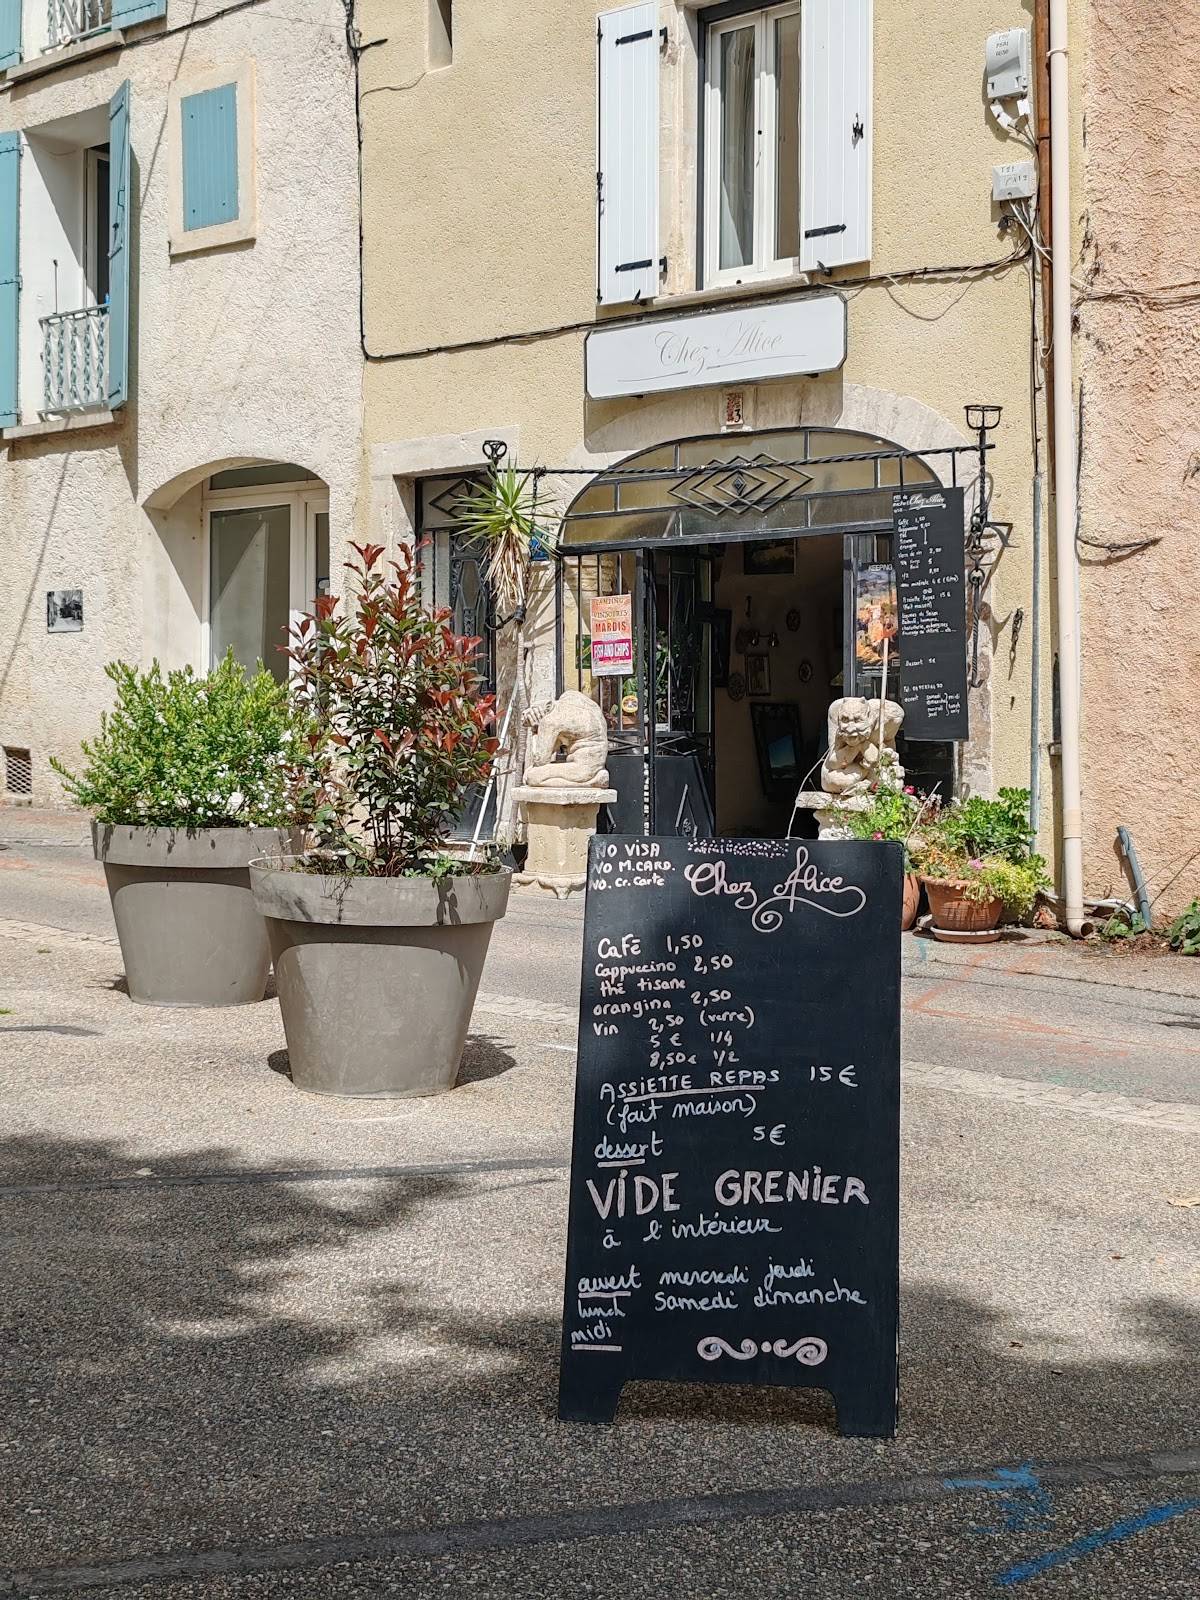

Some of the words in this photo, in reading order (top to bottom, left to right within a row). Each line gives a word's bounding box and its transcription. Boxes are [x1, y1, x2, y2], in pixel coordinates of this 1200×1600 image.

[655, 330, 709, 377] Chez
[717, 320, 784, 358] Alice
[595, 621, 627, 633] MARDIS
[614, 641, 630, 657] CHIPS
[595, 841, 618, 860] NO
[590, 860, 613, 875] NO
[684, 860, 757, 910] Chez
[666, 934, 703, 955] 1,50
[594, 960, 677, 985] Cappuccino
[693, 954, 733, 975] 2,50
[637, 977, 686, 992] tisane
[593, 999, 672, 1019] orangina
[690, 989, 732, 1007] 2,50
[648, 1014, 685, 1033] 2,50
[700, 1005, 755, 1029] (verre)
[649, 1034, 661, 1048] 5
[669, 1033, 683, 1047] €
[710, 1030, 733, 1047] 1/4
[712, 1050, 740, 1067] 1/2
[709, 1069, 780, 1088] REPAS
[671, 1093, 756, 1119] maison)
[594, 1130, 664, 1159] dessert
[659, 1264, 749, 1286] mercredi
[763, 1256, 816, 1289] jeudi
[577, 1297, 626, 1318] lunch
[752, 1278, 867, 1308] dimanche
[571, 1318, 613, 1342] midi
